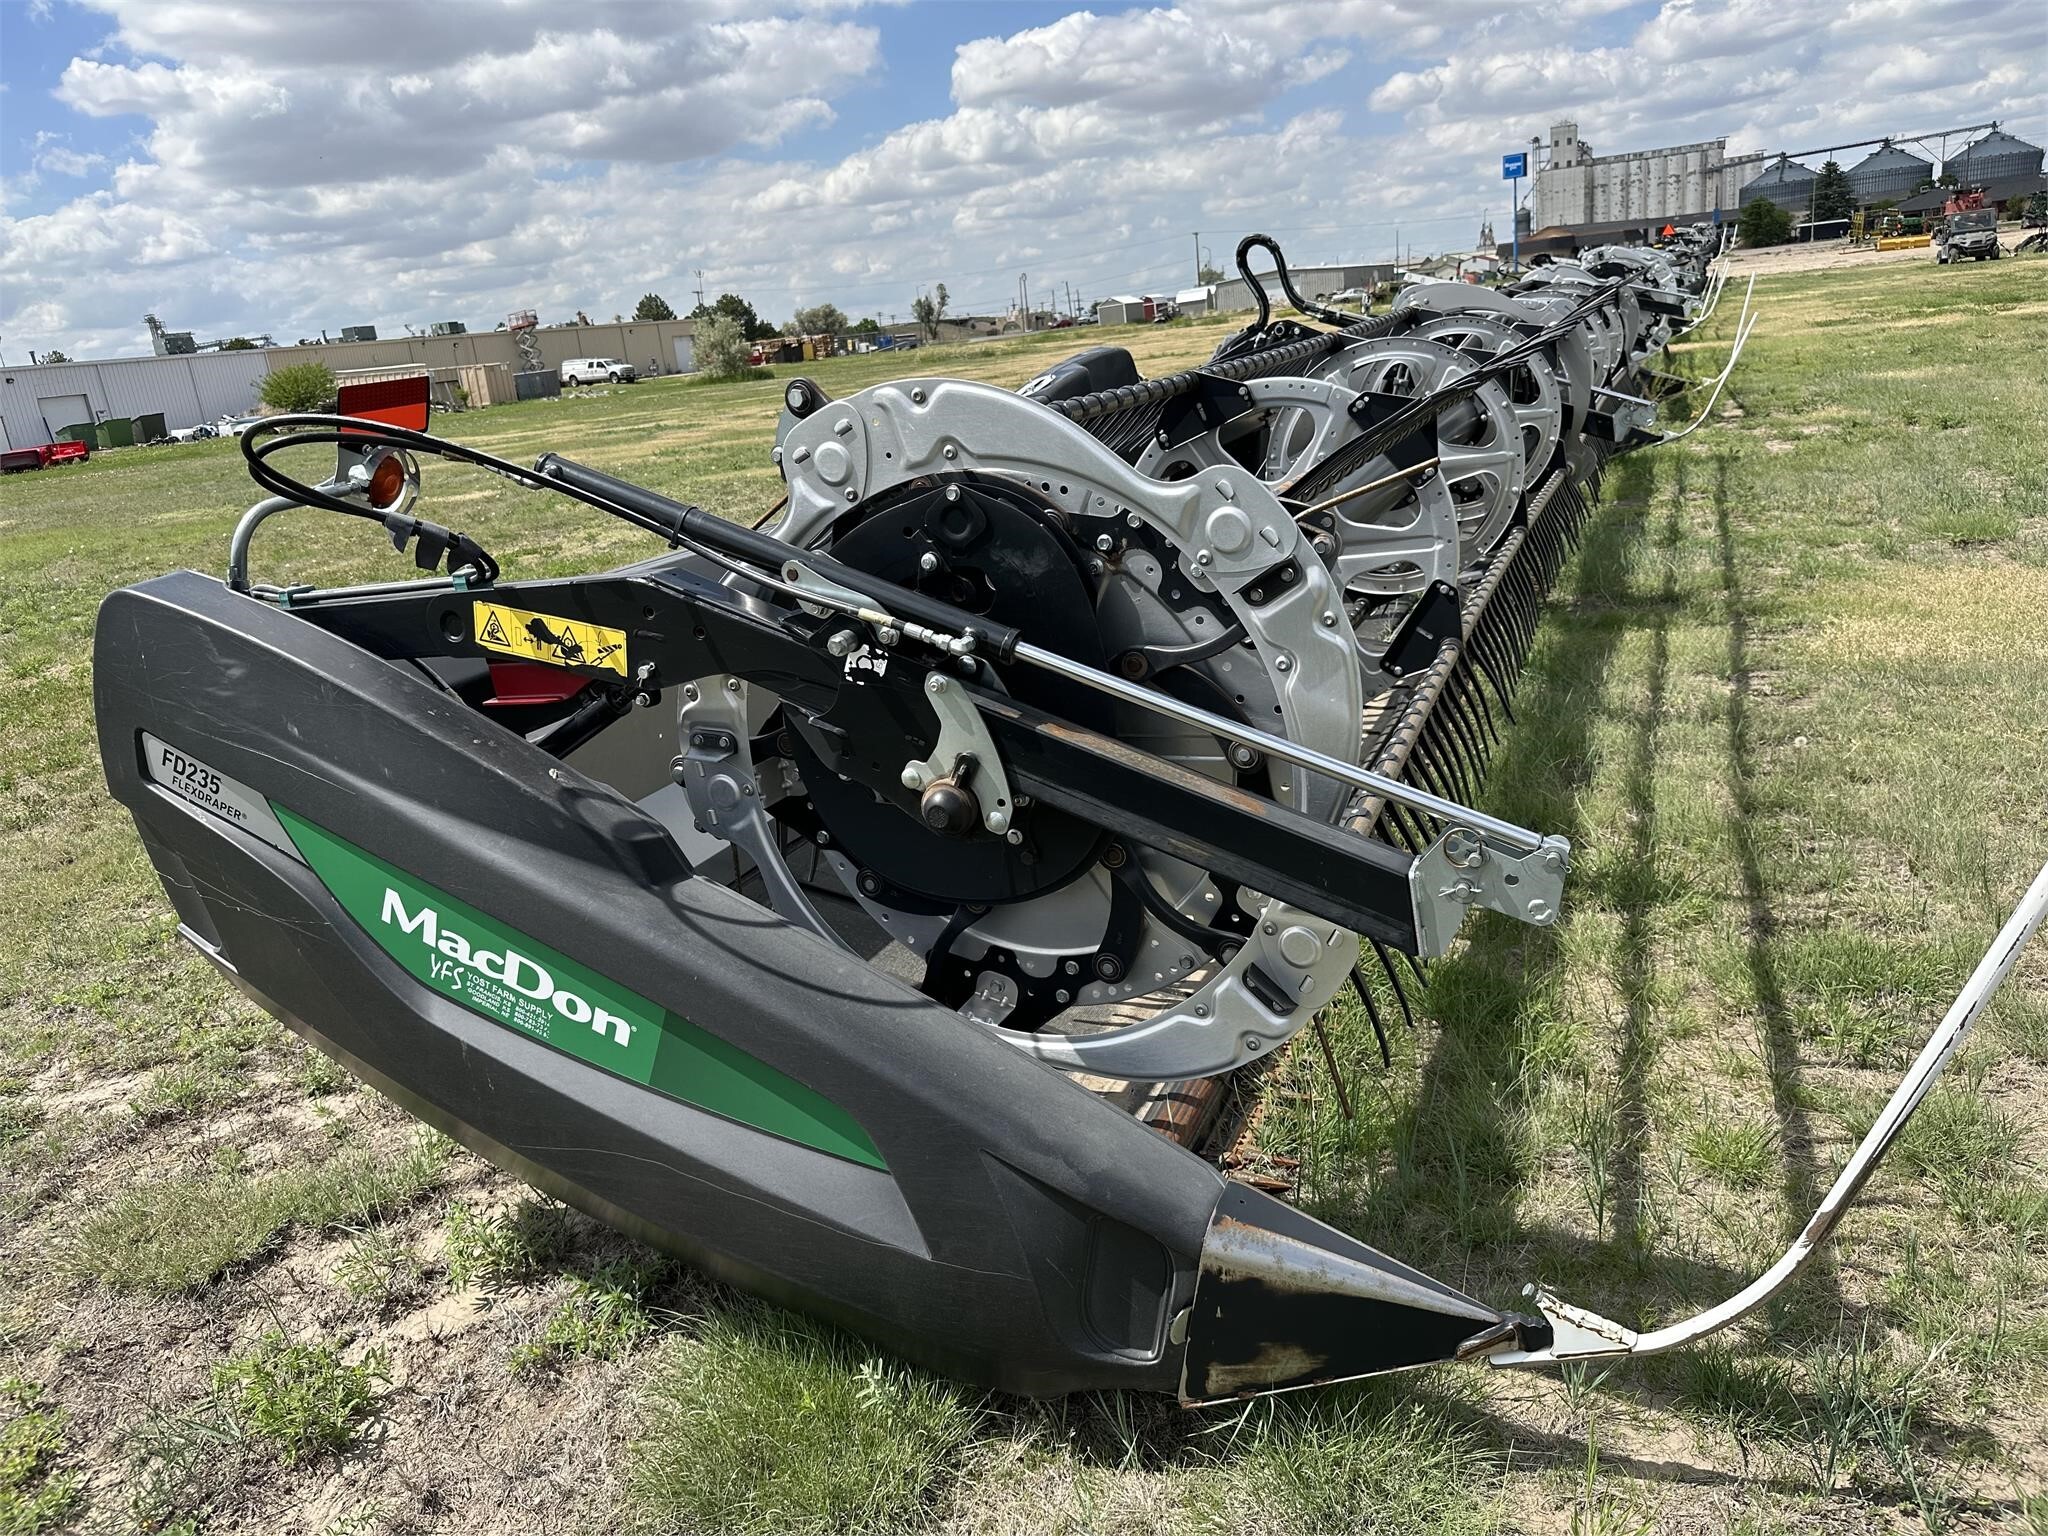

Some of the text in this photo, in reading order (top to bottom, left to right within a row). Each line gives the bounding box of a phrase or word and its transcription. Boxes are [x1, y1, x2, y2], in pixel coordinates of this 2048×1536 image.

[161, 748, 223, 795] FD235
[431, 953, 464, 990] YFS
[467, 972, 553, 1020] YOST FARM SUPPLY
